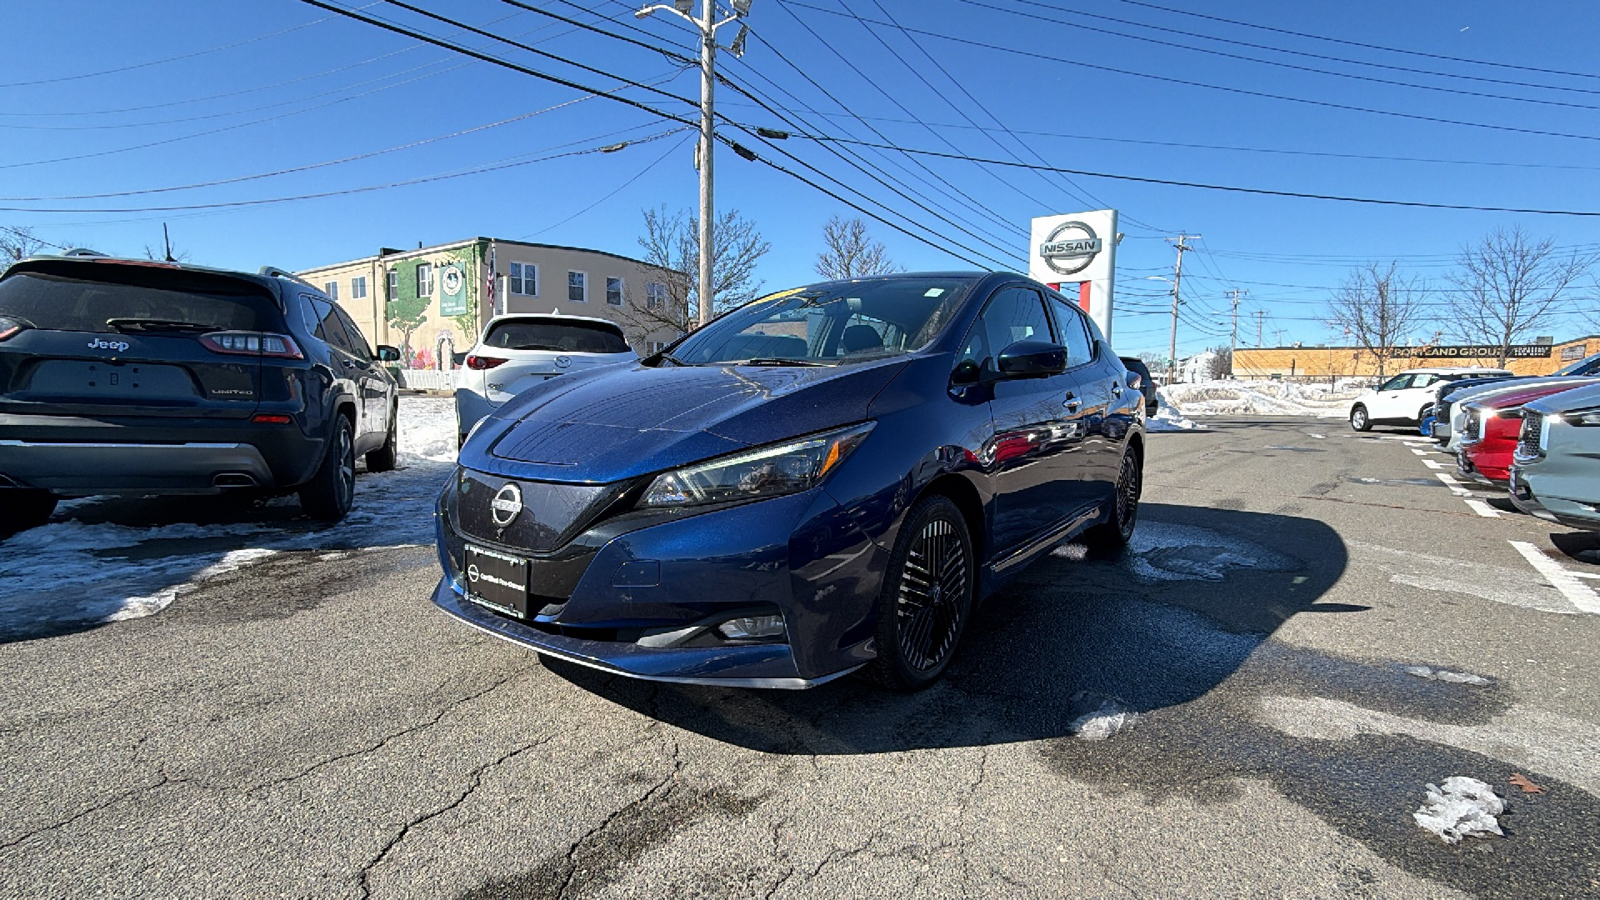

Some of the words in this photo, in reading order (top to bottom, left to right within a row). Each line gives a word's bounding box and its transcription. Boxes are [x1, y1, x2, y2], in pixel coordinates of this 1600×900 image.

[1044, 241, 1096, 254] NISSAN
[87, 337, 130, 352] Jeep
[1394, 347, 1458, 356] PORTLAND
